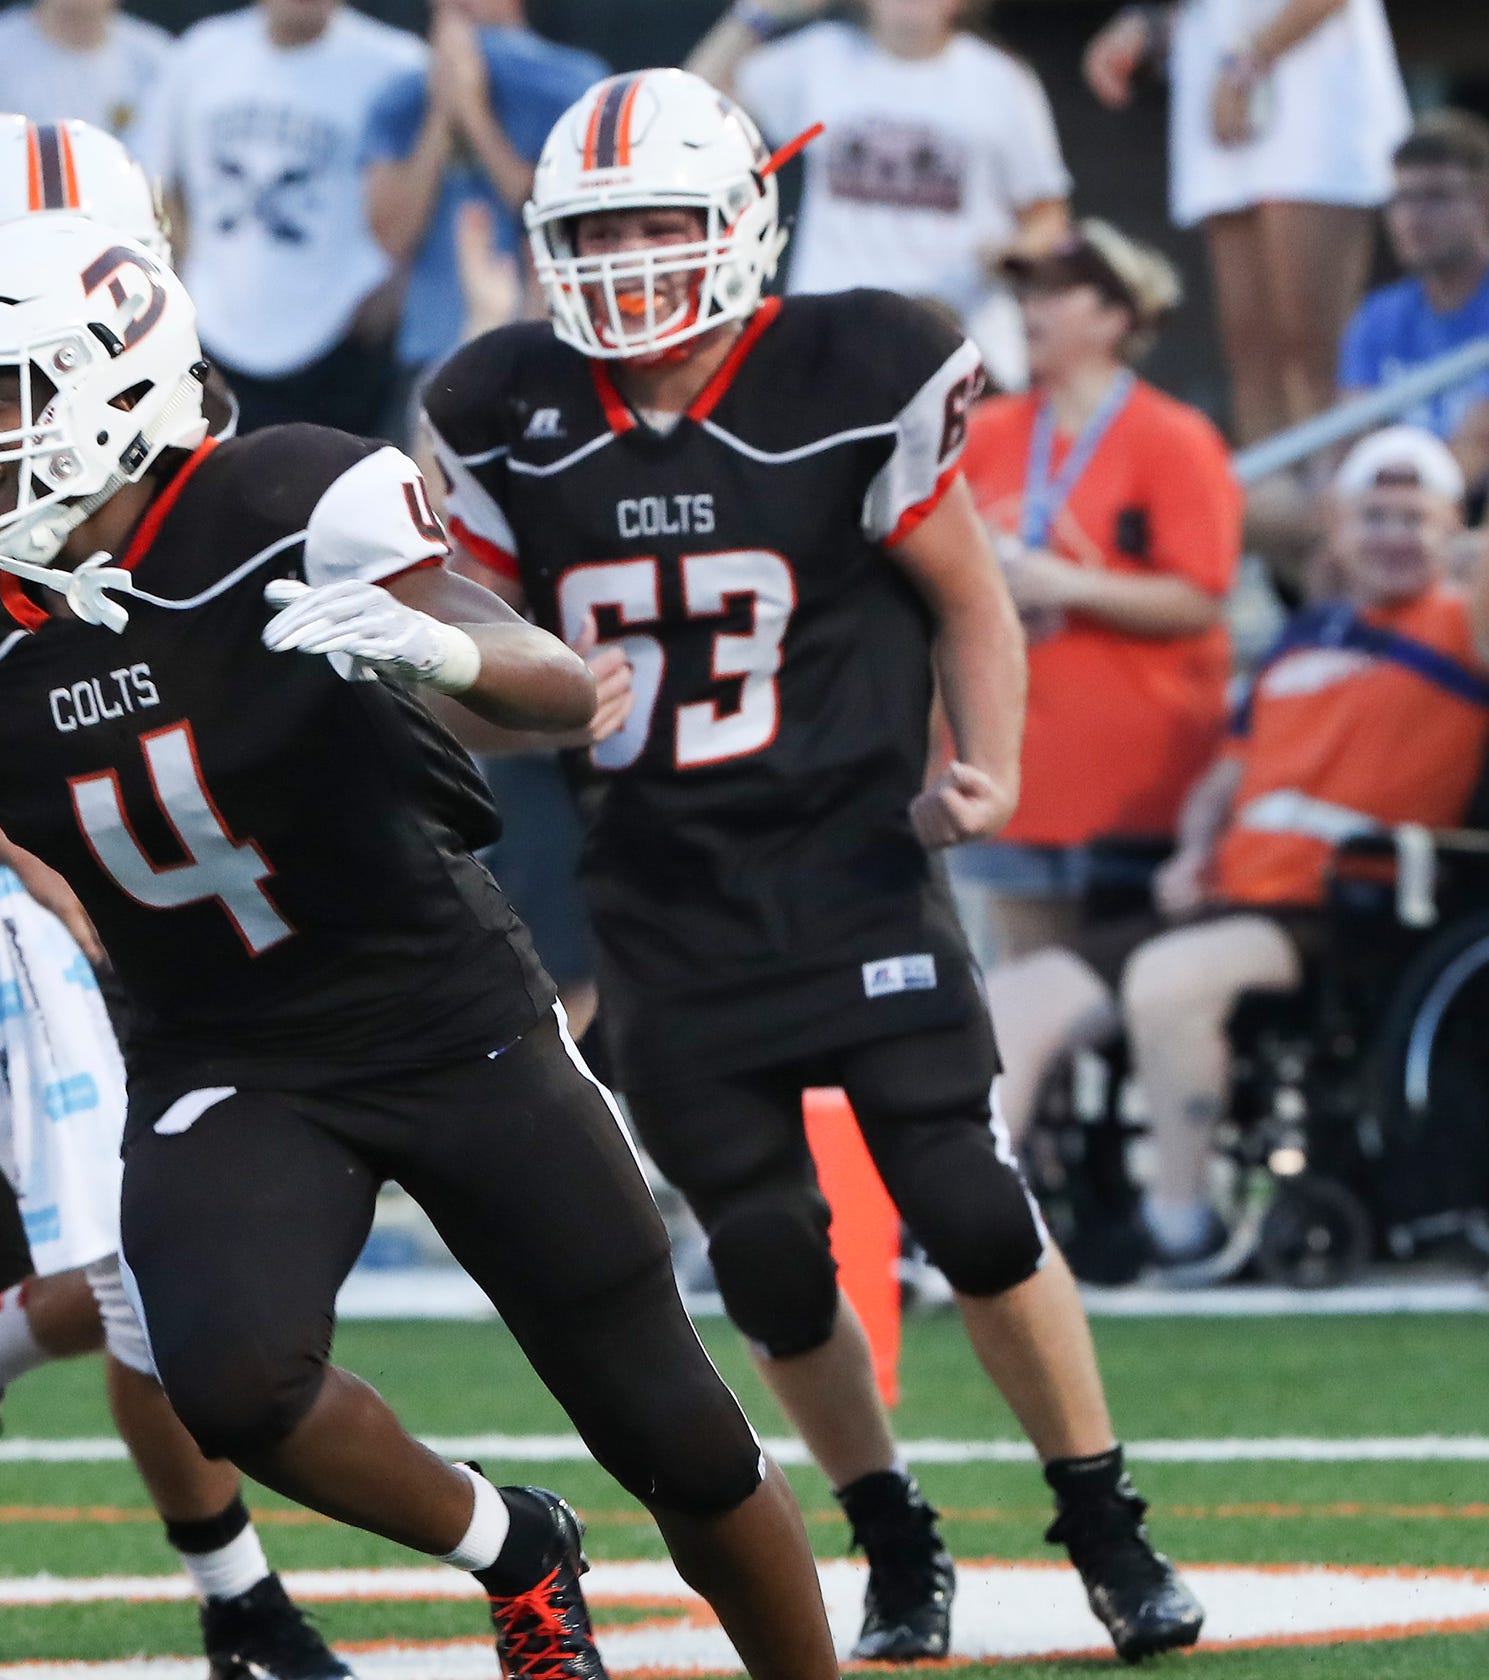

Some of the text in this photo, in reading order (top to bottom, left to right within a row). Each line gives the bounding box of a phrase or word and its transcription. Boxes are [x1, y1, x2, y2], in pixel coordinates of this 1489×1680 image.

[618, 494, 715, 538] COLTS
[49, 662, 161, 733] COLTS
[557, 549, 797, 771] 63
[67, 718, 297, 957] 4
